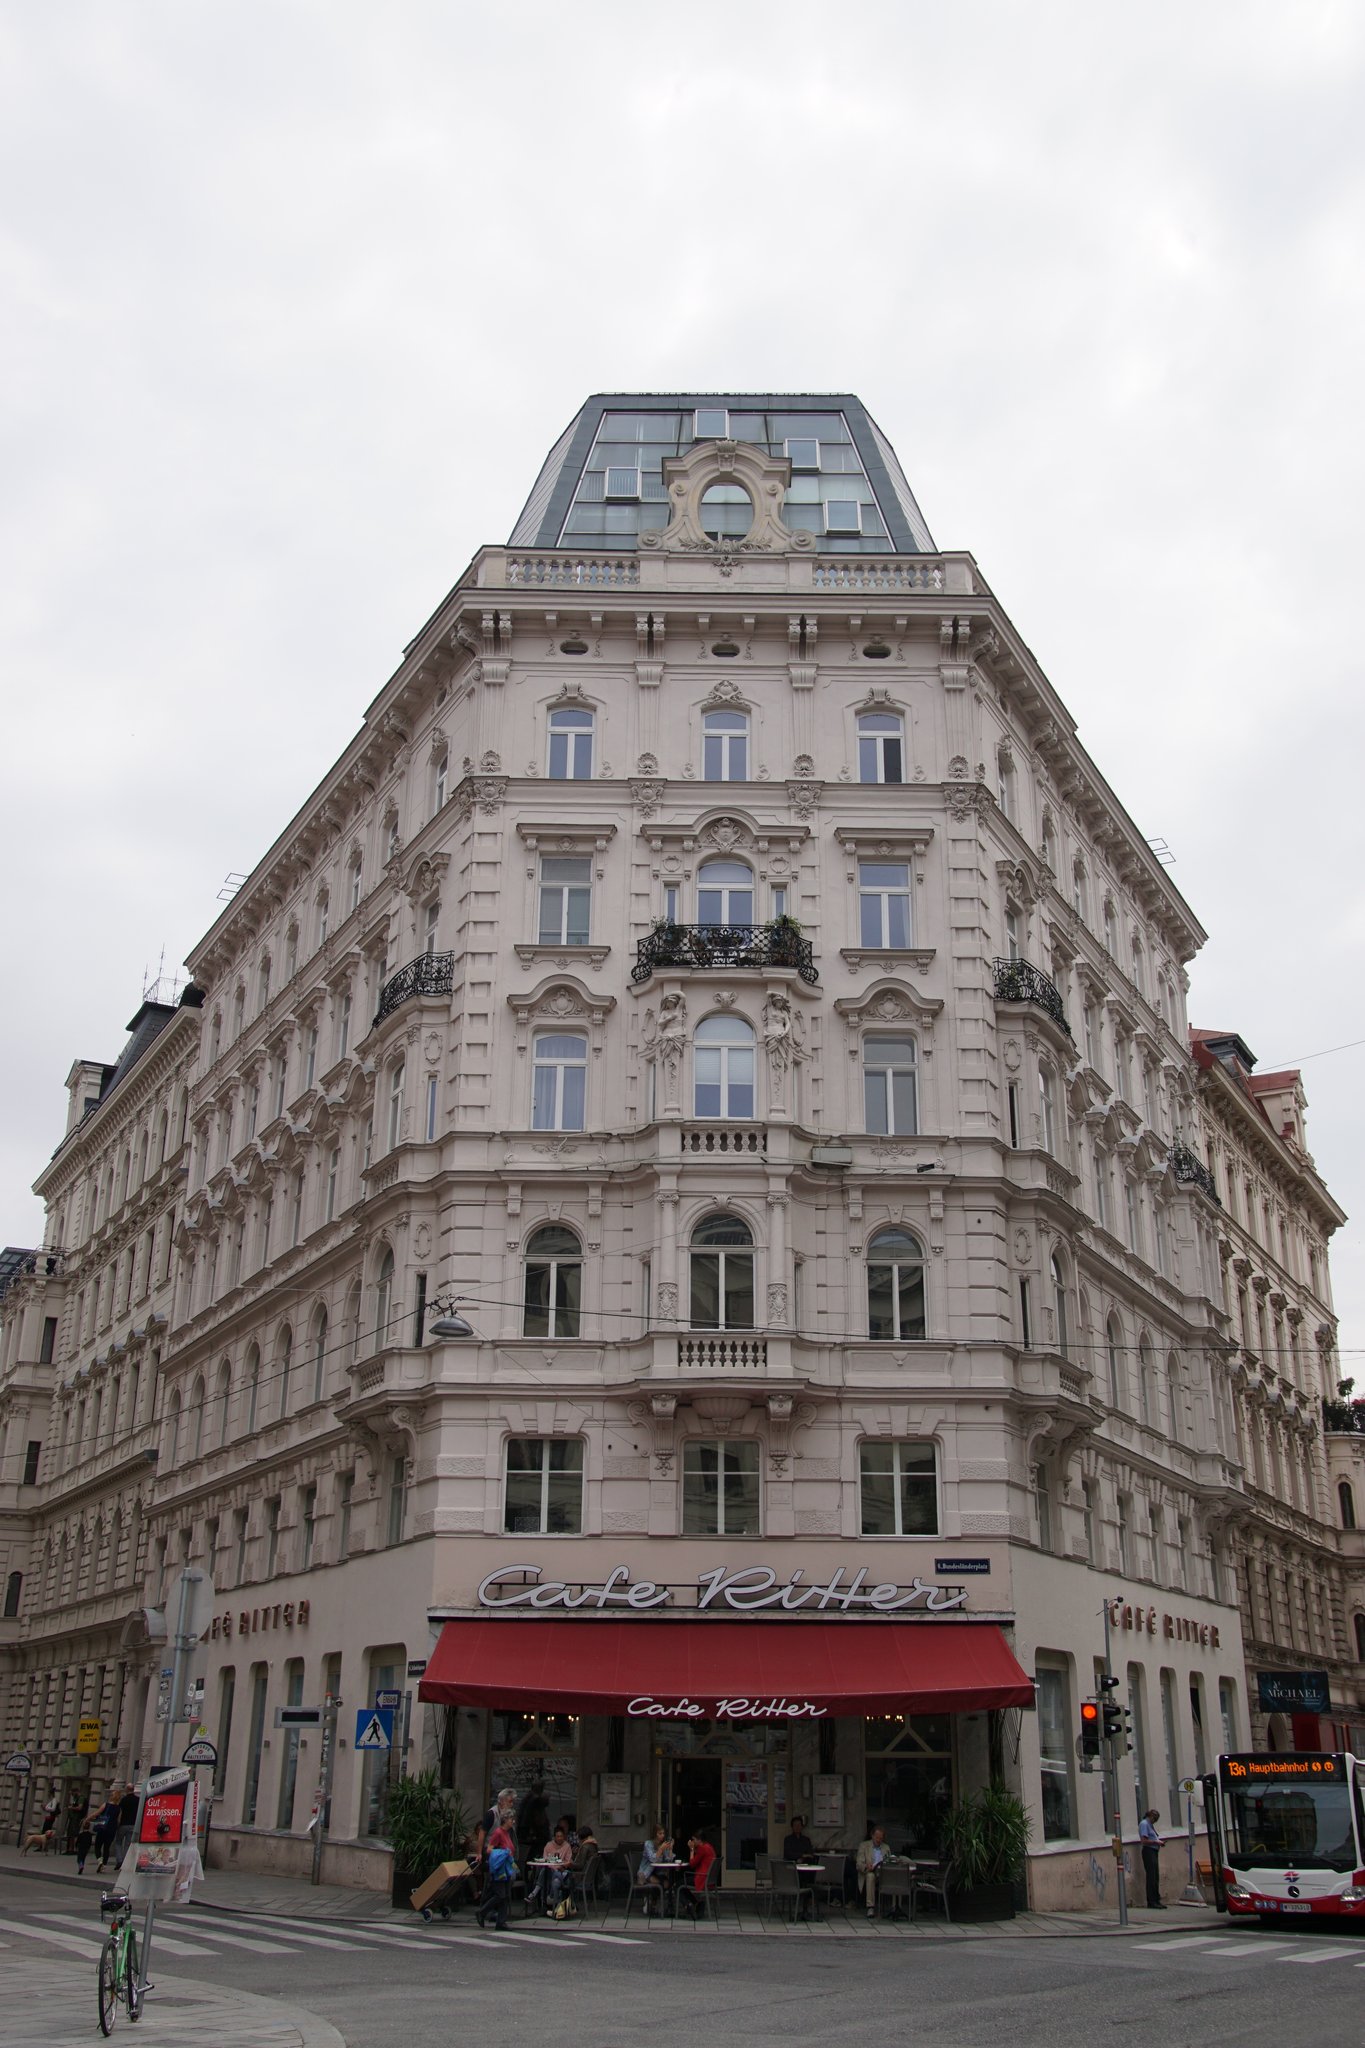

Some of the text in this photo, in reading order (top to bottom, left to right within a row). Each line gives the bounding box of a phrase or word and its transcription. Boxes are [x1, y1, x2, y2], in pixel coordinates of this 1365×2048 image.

[478, 1564, 969, 1610] Cafe Ritter
[199, 1599, 310, 1641] FÉ RITTER
[1108, 1600, 1220, 1648] CAFÉ RITTER
[627, 1697, 827, 1718] Cafe Ritter
[1228, 1761, 1246, 1776] 13A
[1249, 1761, 1308, 1774] Hauptbahnhof
[147, 1797, 160, 1807] Gut
[156, 1807, 181, 1816] wissen.
